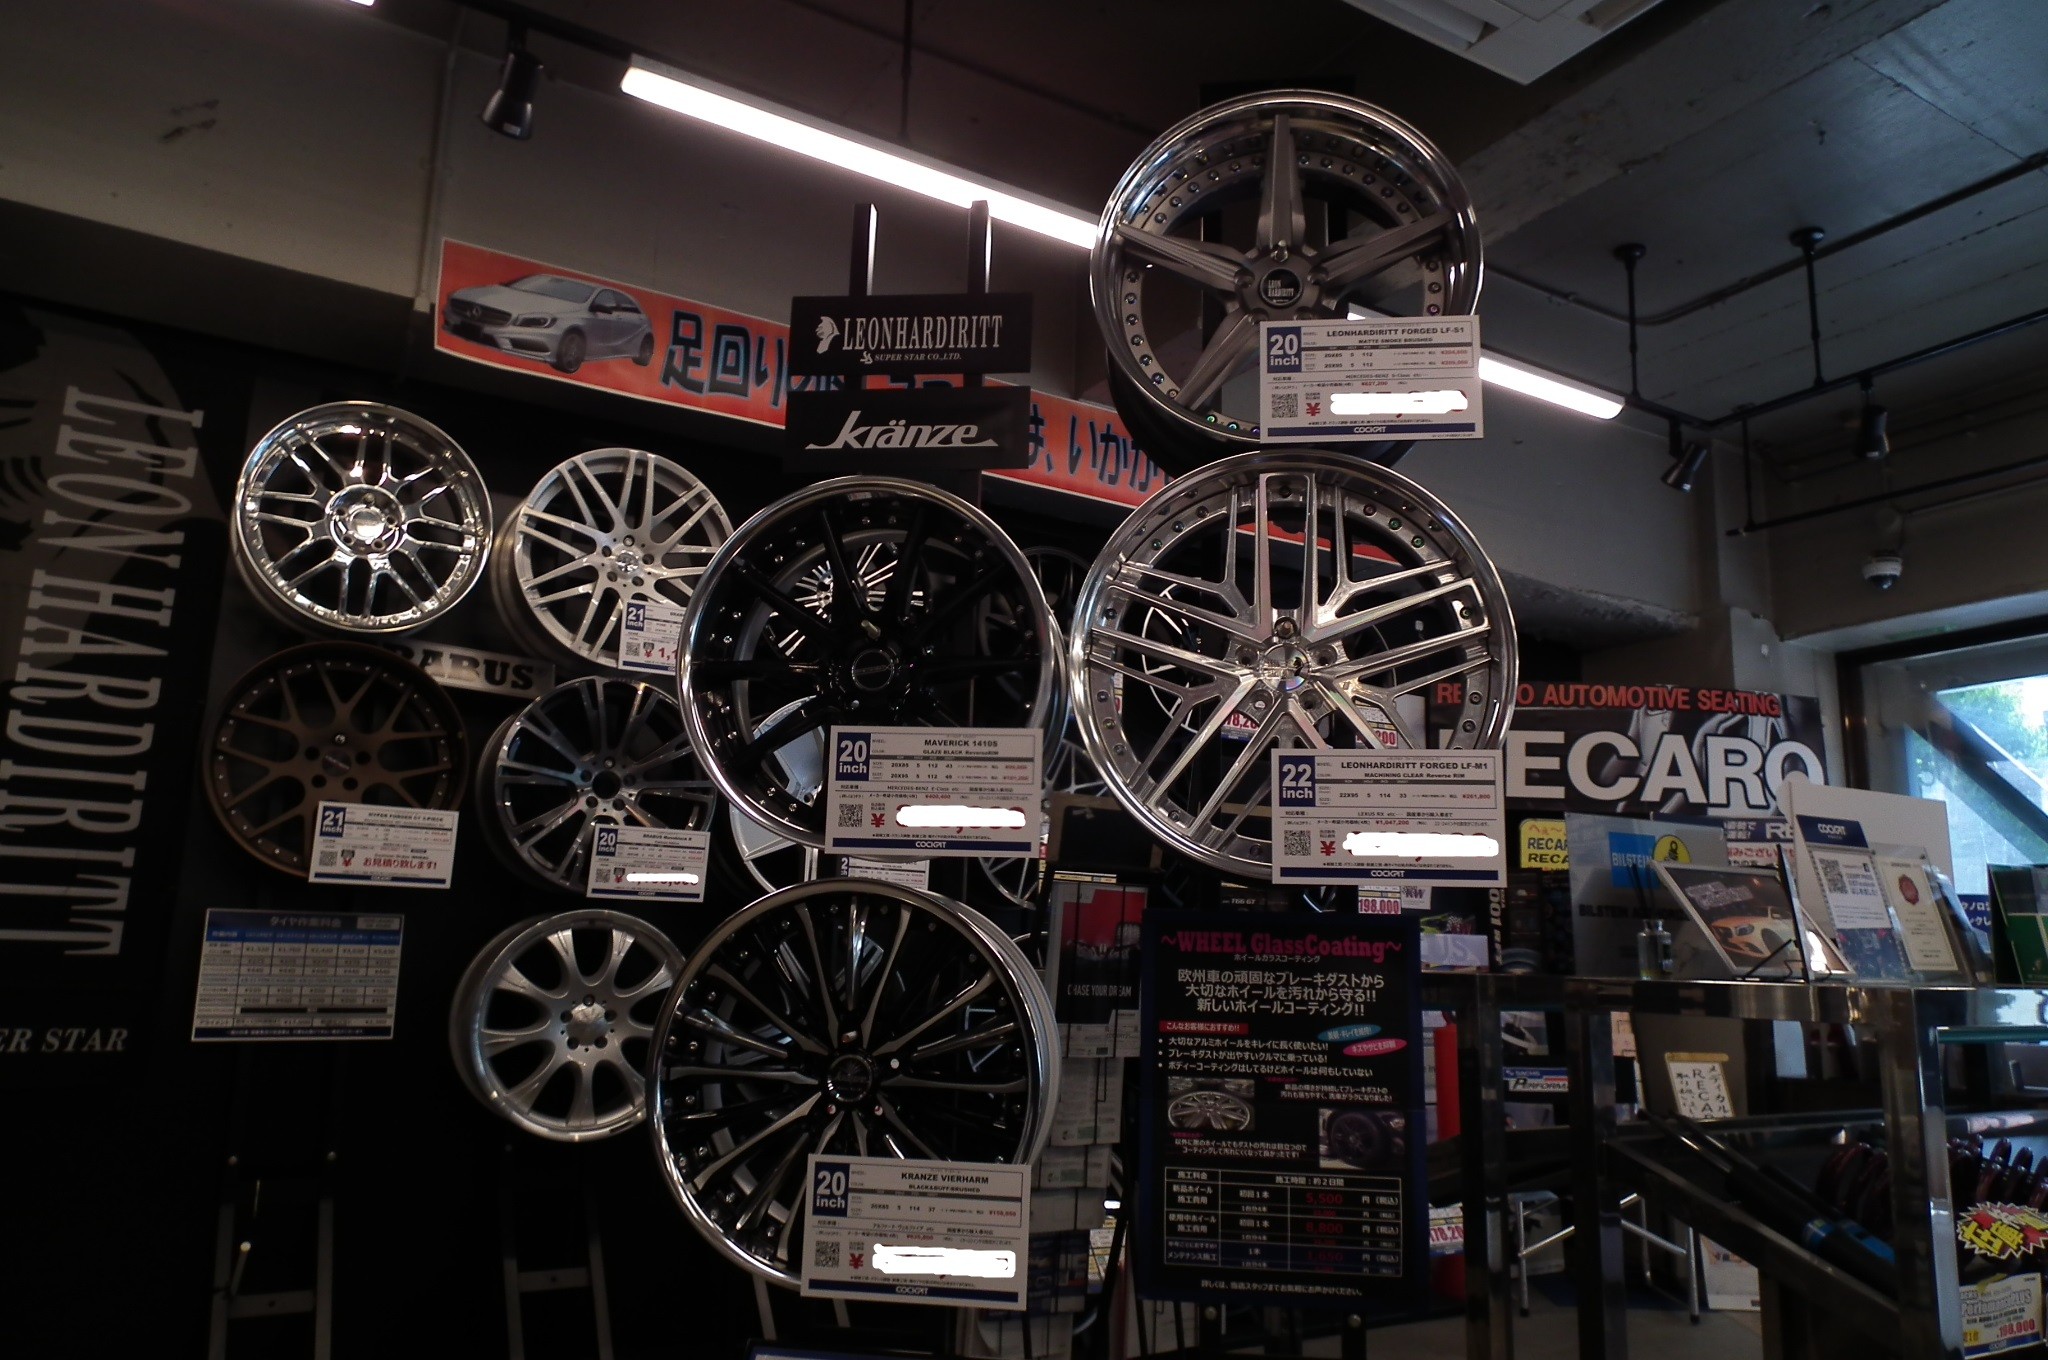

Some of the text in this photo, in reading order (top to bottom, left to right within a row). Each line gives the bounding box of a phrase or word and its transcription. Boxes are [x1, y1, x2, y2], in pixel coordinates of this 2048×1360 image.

[842, 315, 1003, 351] LEONHARDIRITT
[1327, 327, 1465, 337] LEONHARDIRITT FORGED LF-S1
[1270, 334, 1299, 355] 20
[874, 353, 899, 362] SUPER
[901, 353, 925, 362] STAR
[1270, 355, 1299, 366] inch
[805, 410, 998, 450] kränze
[1354, 426, 1387, 434] COCKPIT
[628, 607, 644, 621] 21
[0, 385, 204, 956] LEONHARDIRITT
[1543, 684, 1690, 709] AUTOMOTIVE
[1696, 689, 1781, 717] SEATING
[839, 740, 867, 762] 20
[839, 763, 867, 774] inch
[1341, 762, 1488, 770] LEONHARDIRITT FORGED LF-M1
[1439, 729, 1825, 810] ECARO
[1282, 764, 1312, 787] 22
[1282, 787, 1313, 799] inch
[324, 811, 344, 826] 21
[871, 813, 885, 828] ¥
[599, 832, 616, 846] 20
[916, 841, 946, 849] COCKPIT
[1320, 841, 1336, 856] ¥
[1371, 870, 1405, 878] COCKPIT
[1178, 969, 1385, 988] 欧州車の頑固なブレーキダストから
[41, 1026, 129, 1053] STAR
[816, 1171, 846, 1196] 20
[901, 1172, 989, 1184] KRANZE VIERHARM
[816, 1197, 845, 1209] inch
[895, 1286, 929, 1296] COCKPIT
